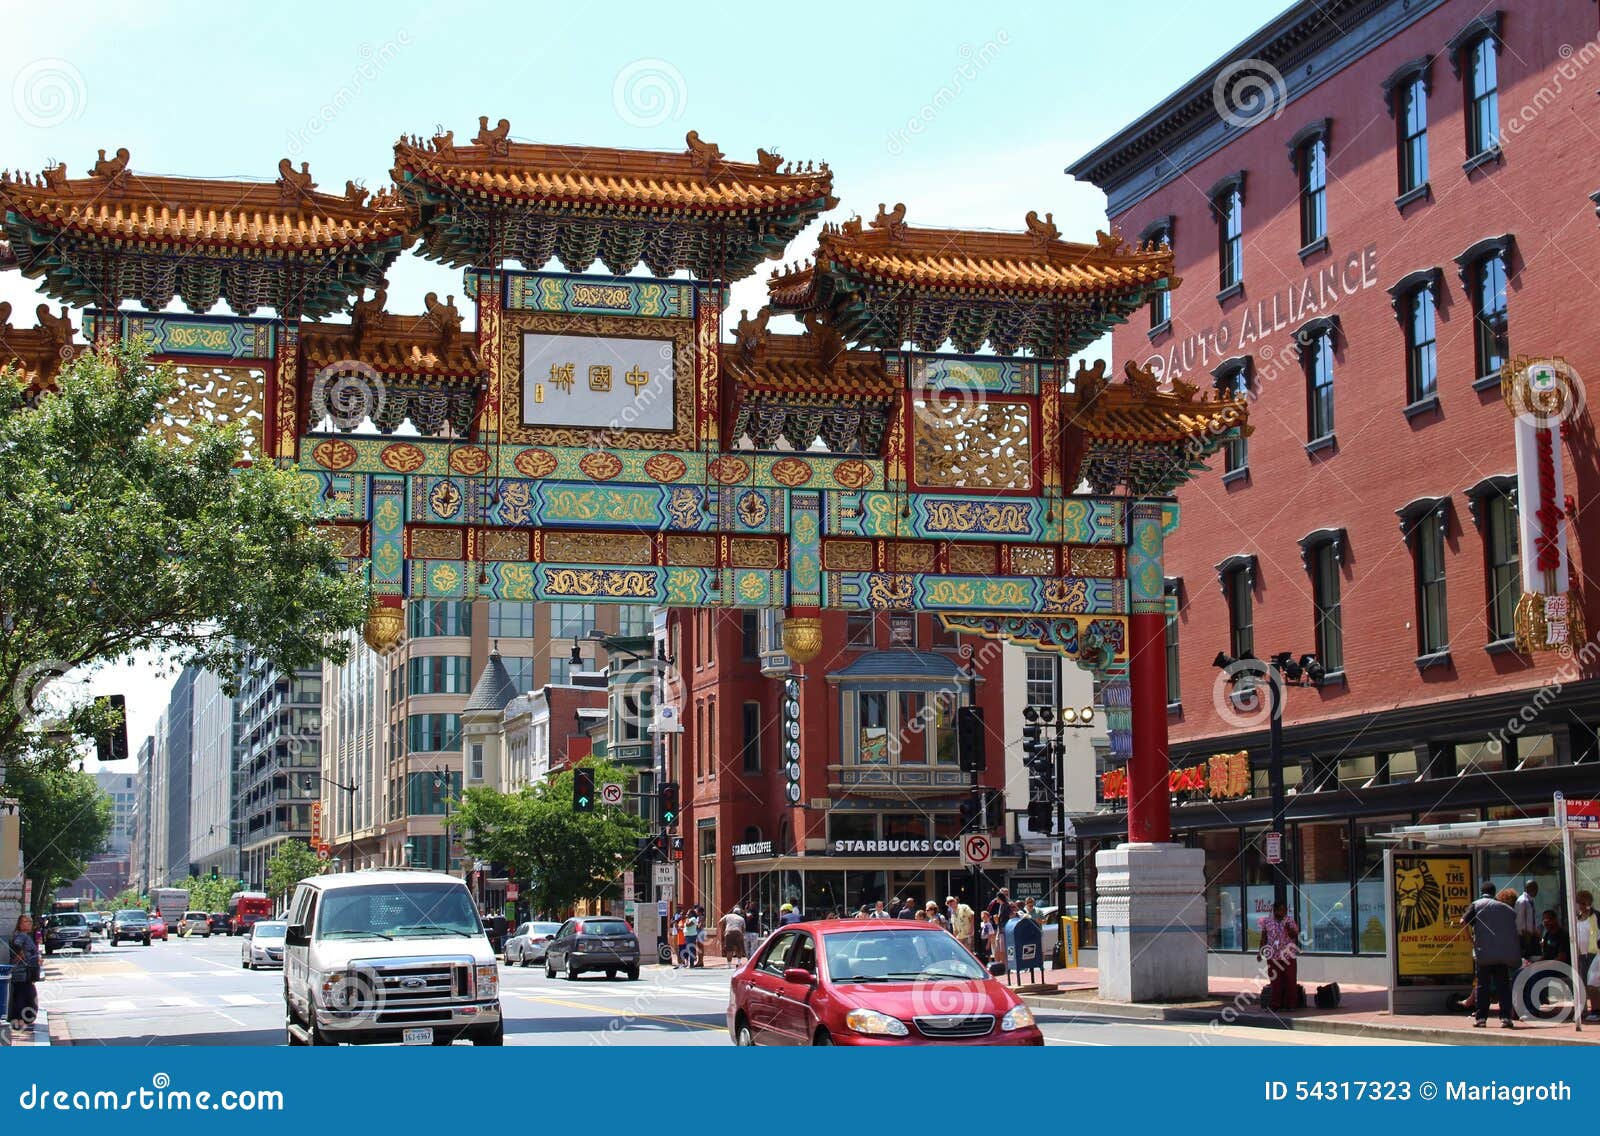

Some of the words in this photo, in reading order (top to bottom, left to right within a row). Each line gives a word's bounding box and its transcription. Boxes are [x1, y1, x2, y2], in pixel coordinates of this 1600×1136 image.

[1166, 320, 1232, 384] AUTO
[1238, 242, 1378, 349] ALLIANCE
[835, 839, 930, 852] STARBUCKS
[936, 839, 961, 852] COF
[1445, 873, 1465, 883] THE
[1442, 885, 1468, 902] LION
